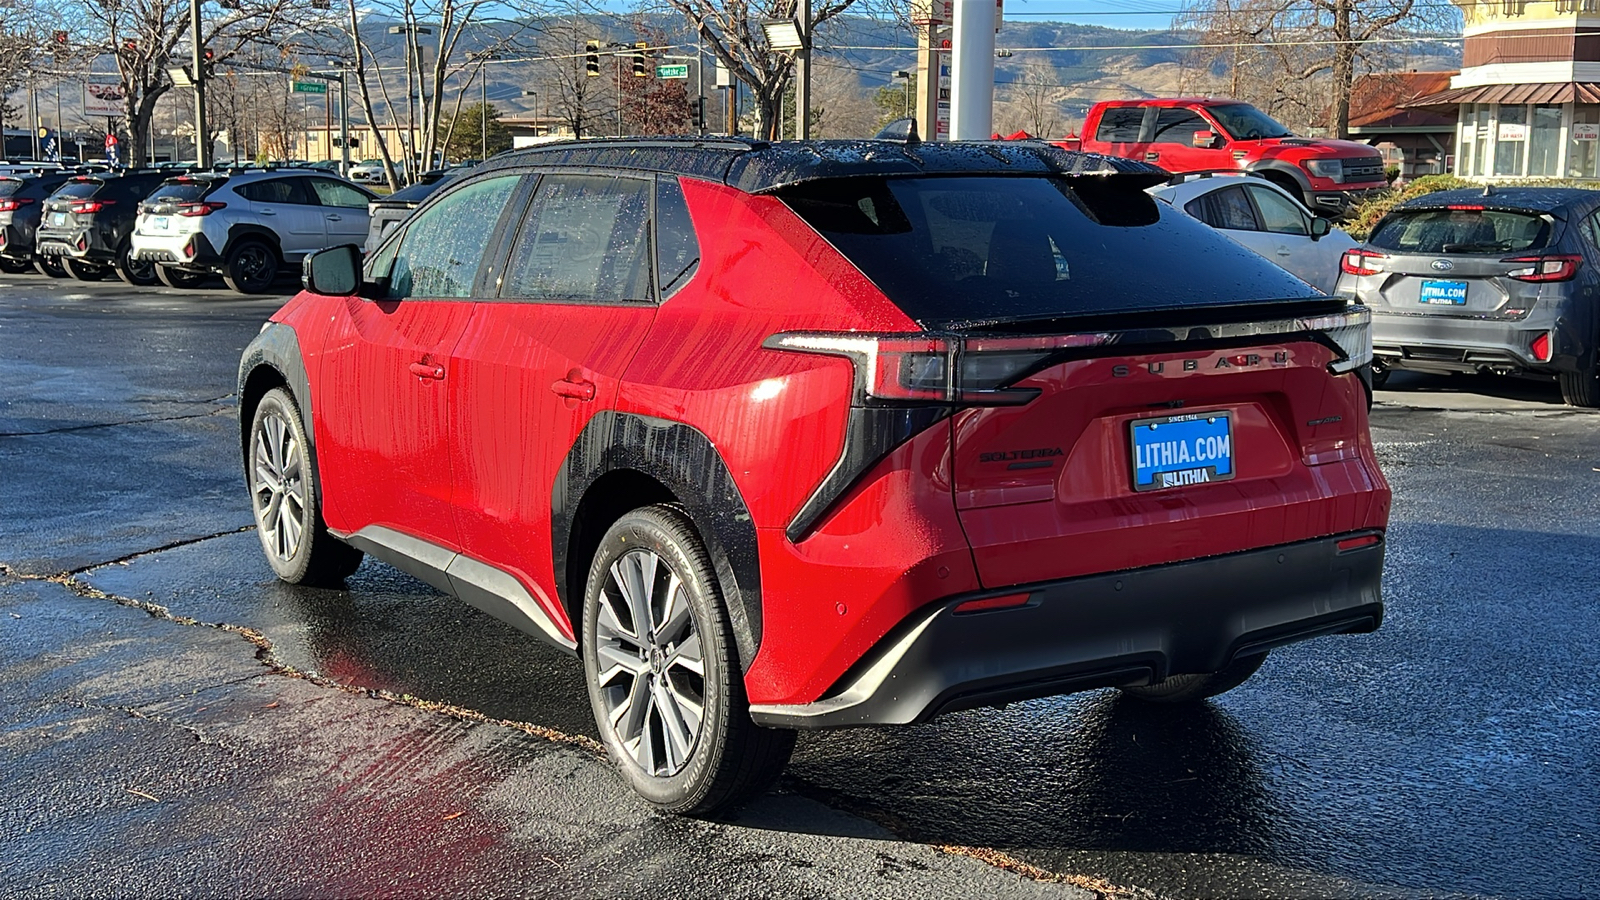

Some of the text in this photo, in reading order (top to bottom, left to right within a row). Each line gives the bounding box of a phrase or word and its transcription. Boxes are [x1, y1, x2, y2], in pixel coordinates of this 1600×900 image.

[1111, 351, 1288, 379] SUBARU
[1168, 416, 1184, 424] SINCE
[979, 446, 1064, 463] SOLTERRA
[1136, 434, 1230, 469] LITHIA.COM
[1173, 468, 1210, 487] LITHIA
